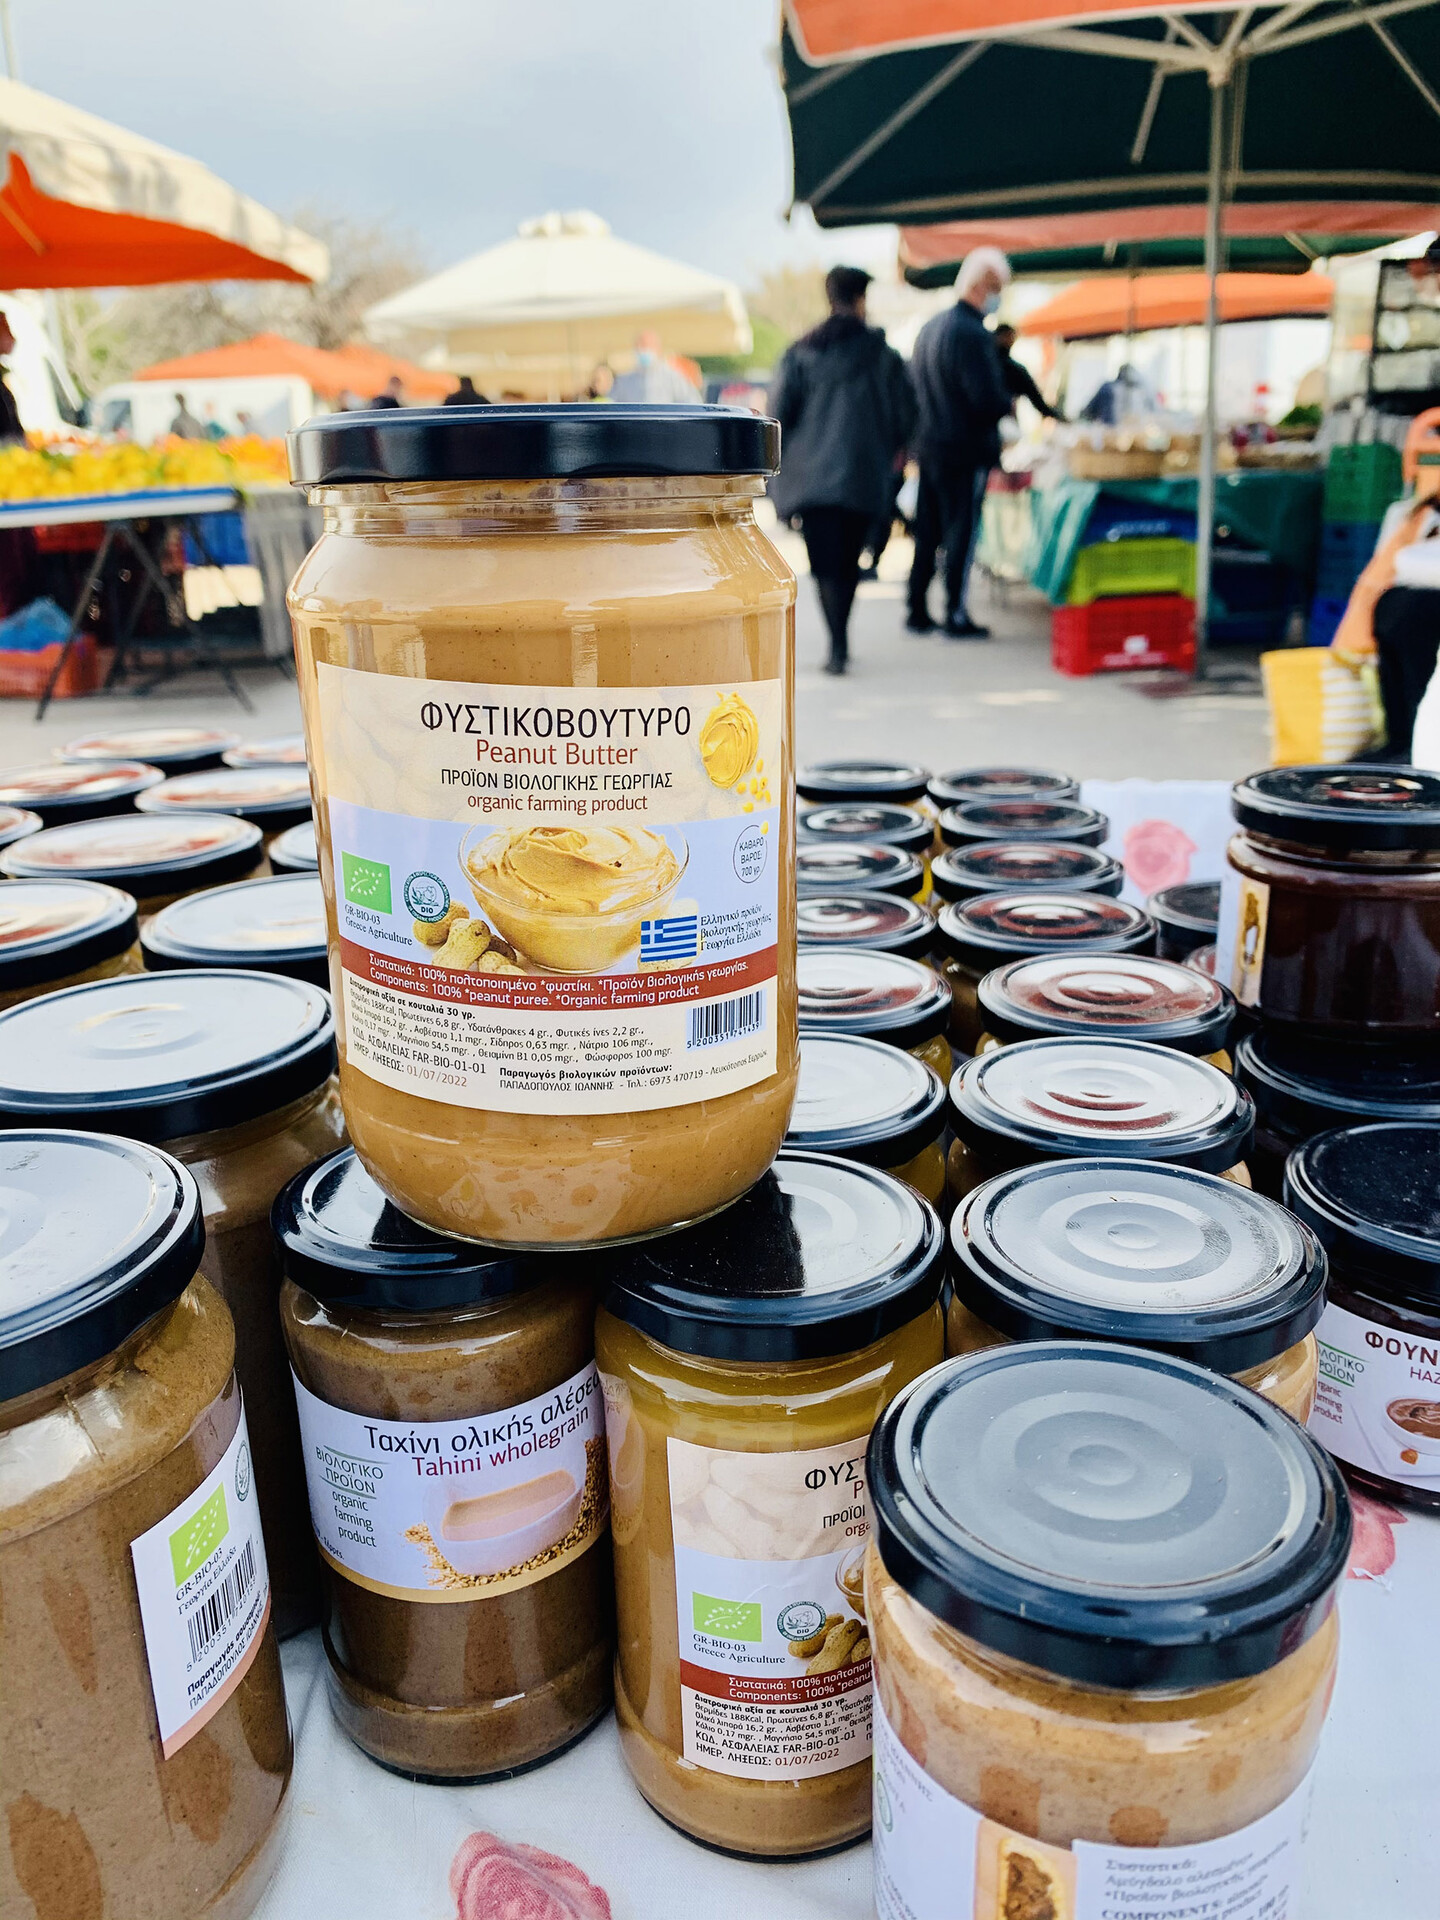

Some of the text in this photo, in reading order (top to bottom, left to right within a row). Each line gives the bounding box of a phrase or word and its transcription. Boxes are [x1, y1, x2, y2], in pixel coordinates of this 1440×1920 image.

[420, 701, 691, 738] ΦΥΣΤΙΚΟΒΟΥΤΥΡΟ
[476, 738, 638, 765] Peanut Butter
[441, 768, 673, 791] ΠΡΟΪΟΝ ΒΙΟΛΟΓΙΚΗΣ ΓΕΩΡΓΙΑΣ
[467, 794, 648, 816] organic farming product
[741, 867, 753, 877] 700
[344, 904, 381, 925] GR-BIO-03
[420, 906, 434, 914] DIO
[700, 910, 740, 926] Ελληνικό
[345, 916, 413, 946] Greece Agriculture
[701, 936, 735, 951] Γεωργία
[369, 953, 415, 976] Συστατικά:
[418, 966, 447, 983] 100%
[449, 974, 537, 993] πολτοποιημένο
[648, 970, 705, 987] βιολογικής
[707, 961, 749, 980] γεωργίας.
[370, 967, 429, 993] Components:
[432, 983, 462, 999] 100%
[514, 994, 552, 1007] puree.
[611, 990, 655, 1007] farming
[659, 985, 699, 1003] product
[381, 992, 396, 1003] αξία
[397, 998, 406, 1006] σε
[408, 1001, 445, 1014] κουταλιά
[446, 1007, 459, 1016] 30
[461, 1010, 476, 1020] γρ.
[383, 1015, 397, 1027] 16,2
[414, 1025, 447, 1040] Ασβέστιο
[450, 1033, 462, 1042] 1,1
[490, 1037, 524, 1049] Σίδηρος
[579, 1039, 610, 1051] Νάτριο
[612, 1038, 629, 1048] 106
[435, 1017, 449, 1028] 6,8
[467, 1021, 526, 1037] Υδατάνθρακες
[529, 1027, 535, 1035] 4
[555, 1027, 591, 1038] Φυτικές
[612, 1026, 627, 1037] 2,2
[696, 1032, 729, 1047] 200351
[364, 1020, 377, 1031] 0,17
[397, 1031, 430, 1048] Μαγνήσιο
[431, 1041, 450, 1052] 54,5
[531, 1053, 553, 1063] 0,05
[585, 1051, 634, 1064] Φώσφορος
[635, 1049, 653, 1058] 100
[368, 1034, 410, 1059] ΑΣΦΑΛΕΙΑΣ
[412, 1052, 487, 1074] FAR-BIO-01-01
[372, 1052, 405, 1074] ΛΗΞΕΩΣ:
[406, 1065, 468, 1088] 01/07/2022
[499, 1064, 673, 1082] Παραγωγός βιολογικών προϊόντων:
[499, 1081, 572, 1092] ΠΑΠΑΔΟΠΟΥΛΟΣ
[574, 1081, 615, 1092] ΙΩΑΝΝΗΣ
[649, 1075, 671, 1086] 6973
[673, 1069, 704, 1083] 470719
[1319, 1347, 1364, 1373] ΛΟΓΙΚΟ
[1319, 1360, 1355, 1383] ΡΟΪΟΝ
[364, 1424, 441, 1455] Ταχίνι
[451, 1413, 533, 1453] ολικής
[412, 1406, 589, 1476] Tahini wholegrain
[316, 1446, 383, 1479] ΒΙΟΛΟΓΙΚΟ
[805, 1455, 867, 1490] ΦΥΣ
[325, 1467, 375, 1494] ΠΡΟΪΟΝ
[332, 1491, 368, 1511] organic
[334, 1505, 374, 1532] farming
[823, 1505, 865, 1529] ΠΡΟΪΟ
[338, 1526, 377, 1547] product
[175, 1547, 223, 1601] GR-BIO-03
[178, 1579, 213, 1616] Γεωργία
[186, 1618, 232, 1673] 5 200351
[693, 1633, 746, 1652] GR-BIO-03
[693, 1643, 786, 1664] Greece Agriculture
[187, 1641, 235, 1696] Παραγωγός
[190, 1637, 246, 1710] ΠΑΠΑΔΟΠΟΥΛΟΣ
[728, 1676, 787, 1691] Συστατικά:
[790, 1678, 820, 1691] 100%
[729, 1688, 801, 1702] Components:
[805, 1685, 835, 1699] 100%
[694, 1693, 742, 1712] Διατροφική
[744, 1705, 763, 1715] αξία
[779, 1703, 819, 1715] κουταλιά
[821, 1701, 832, 1709] 30
[835, 1697, 848, 1708] γρ.
[695, 1702, 727, 1718] Θερμίδες
[730, 1713, 763, 1724] 188Kcal,
[810, 1711, 823, 1721] 6,8
[695, 1711, 716, 1725] Ολικά
[745, 1724, 764, 1733] 16,2
[785, 1722, 822, 1733] Ασβέστιο
[824, 1717, 836, 1728] 1,1
[695, 1720, 716, 1733] Κάλιο
[717, 1728, 735, 1738] 0,17
[764, 1732, 803, 1744] Μαγνήσιο
[805, 1730, 823, 1739] 54,5
[695, 1730, 719, 1746] ΚΩΔ.
[721, 1738, 780, 1754] ΑΣΦΑΛΕΙΑΣ
[783, 1729, 856, 1753] FAR-BIO-01-01
[696, 1742, 840, 1767] ΗΜΕΡ. ΛΗΞΕΩΣ: 01/07/2022
